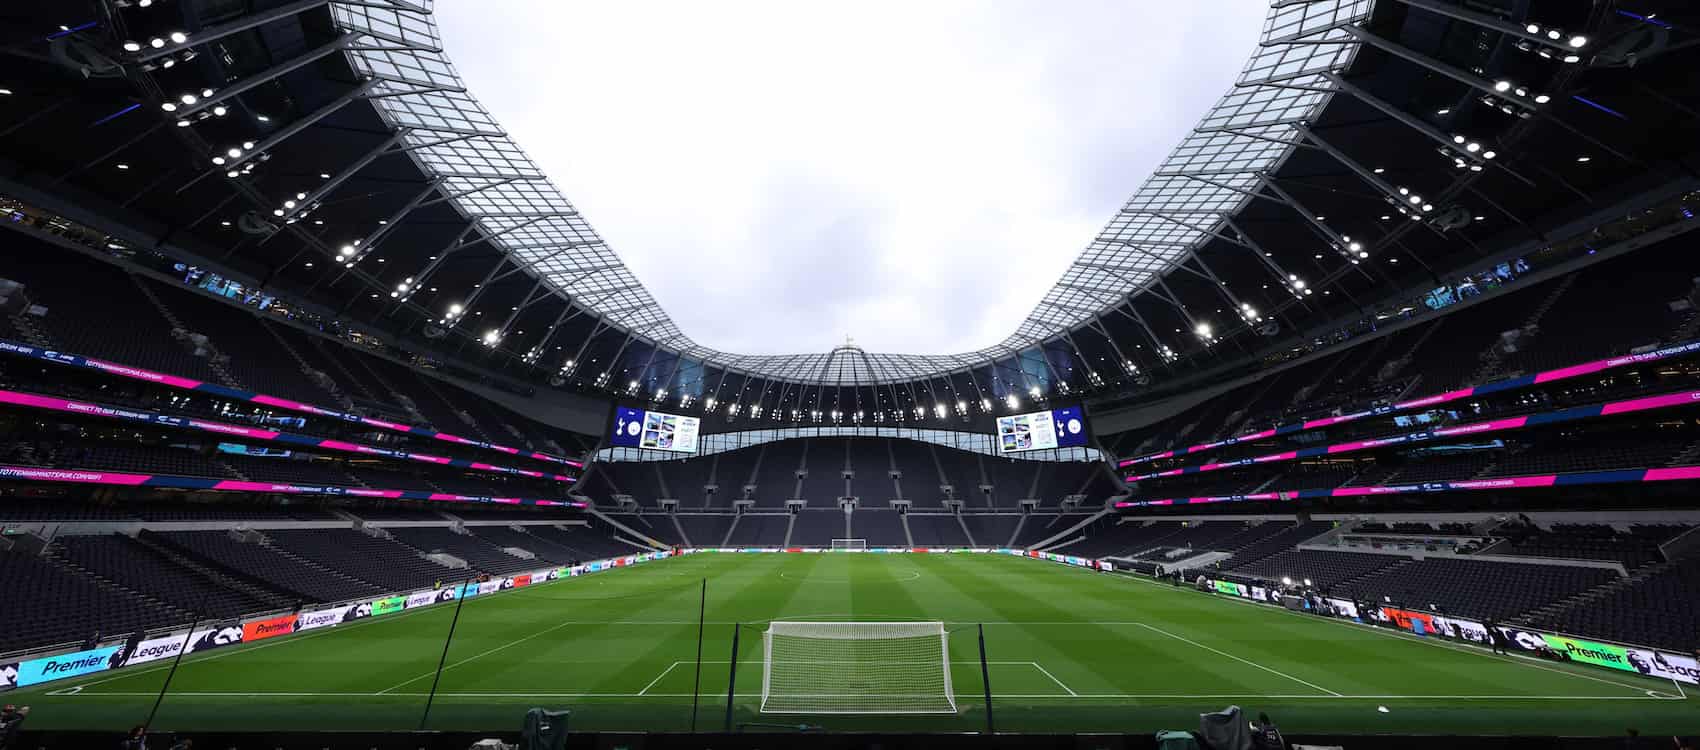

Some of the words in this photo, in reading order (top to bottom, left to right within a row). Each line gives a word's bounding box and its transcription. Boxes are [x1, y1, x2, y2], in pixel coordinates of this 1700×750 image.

[256, 620, 290, 634] Premier
[305, 614, 336, 624] League
[131, 641, 181, 658] League
[1565, 642, 1622, 663] Premier
[42, 655, 105, 675] Premier
